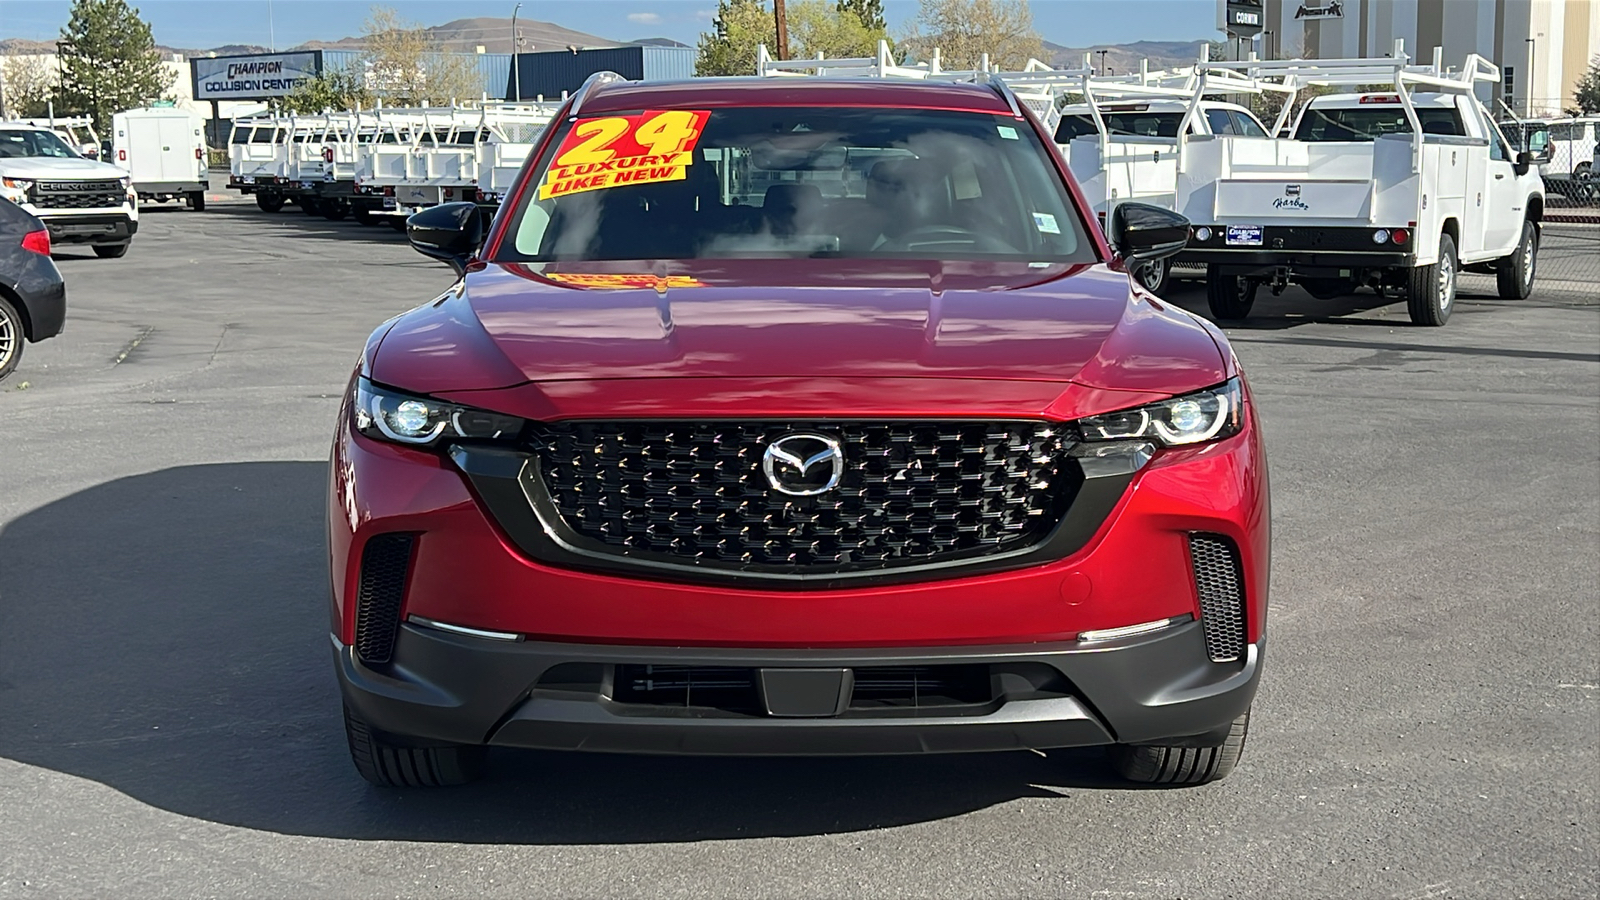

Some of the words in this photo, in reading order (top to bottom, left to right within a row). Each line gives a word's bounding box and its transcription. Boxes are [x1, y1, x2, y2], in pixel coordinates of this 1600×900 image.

[227, 62, 283, 79] CHAMPION
[205, 79, 260, 92] COLLISION
[557, 111, 699, 166] 24
[556, 153, 681, 179] LUXURY
[550, 174, 608, 195] LIKE
[613, 166, 677, 183] NEW
